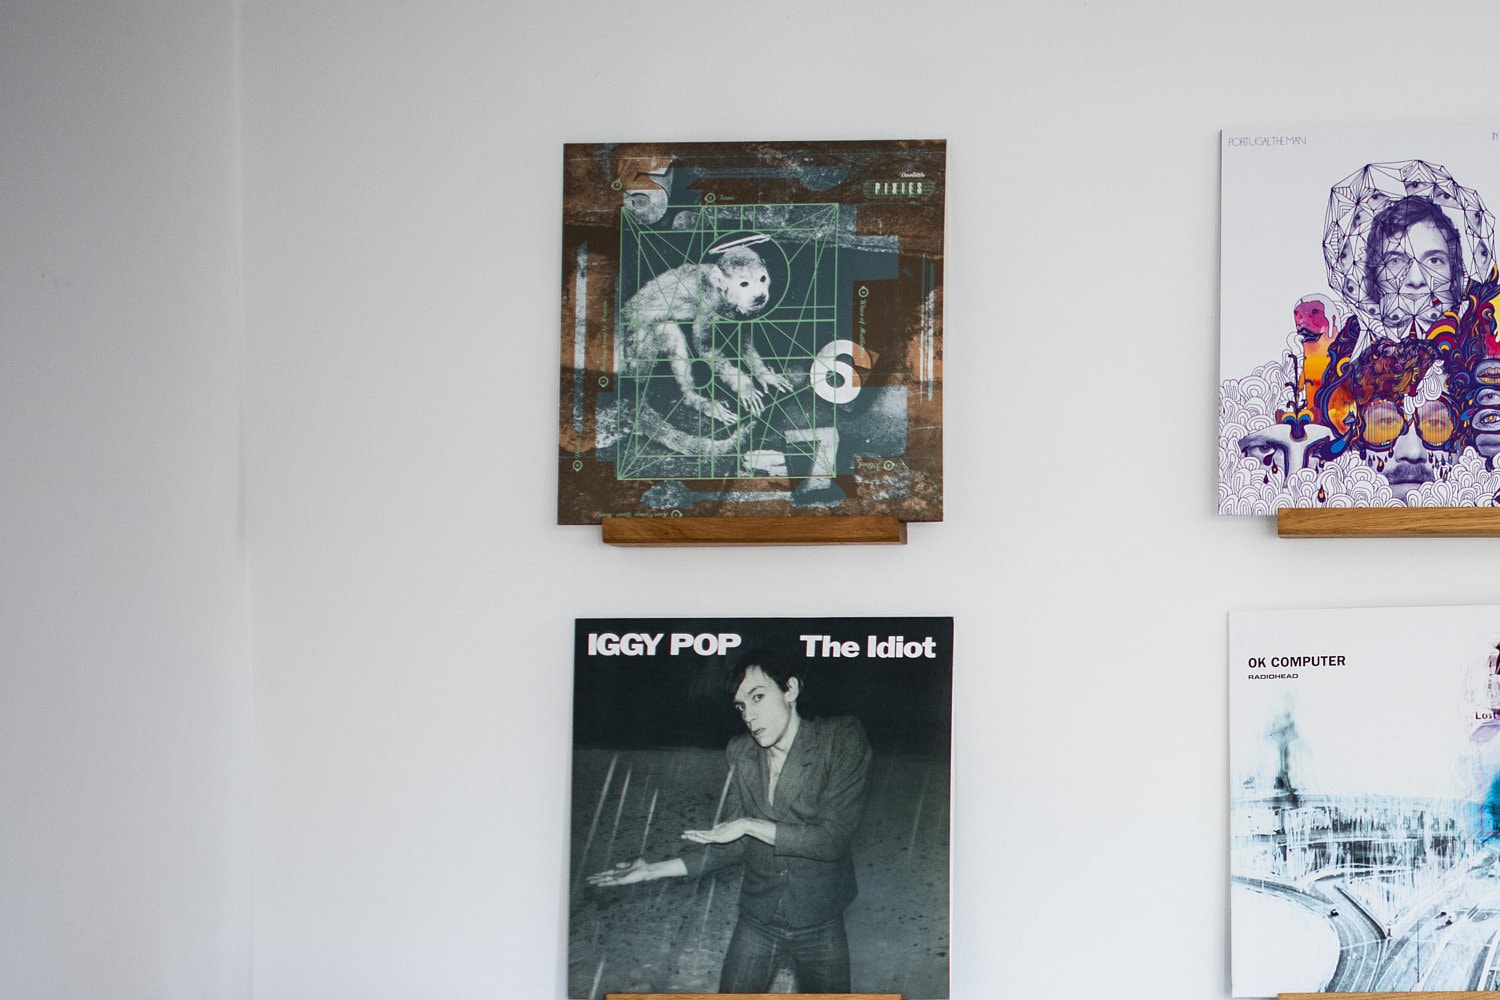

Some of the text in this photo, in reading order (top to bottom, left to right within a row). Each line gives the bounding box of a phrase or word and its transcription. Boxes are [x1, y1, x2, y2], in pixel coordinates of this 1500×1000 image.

[875, 182, 923, 195] PIXIES
[810, 339, 872, 404] 6
[587, 632, 742, 656] IGGY POP
[800, 635, 937, 659] The Idiot
[1248, 655, 1346, 668] OK COMPUTER
[1475, 711, 1498, 719] Lost
